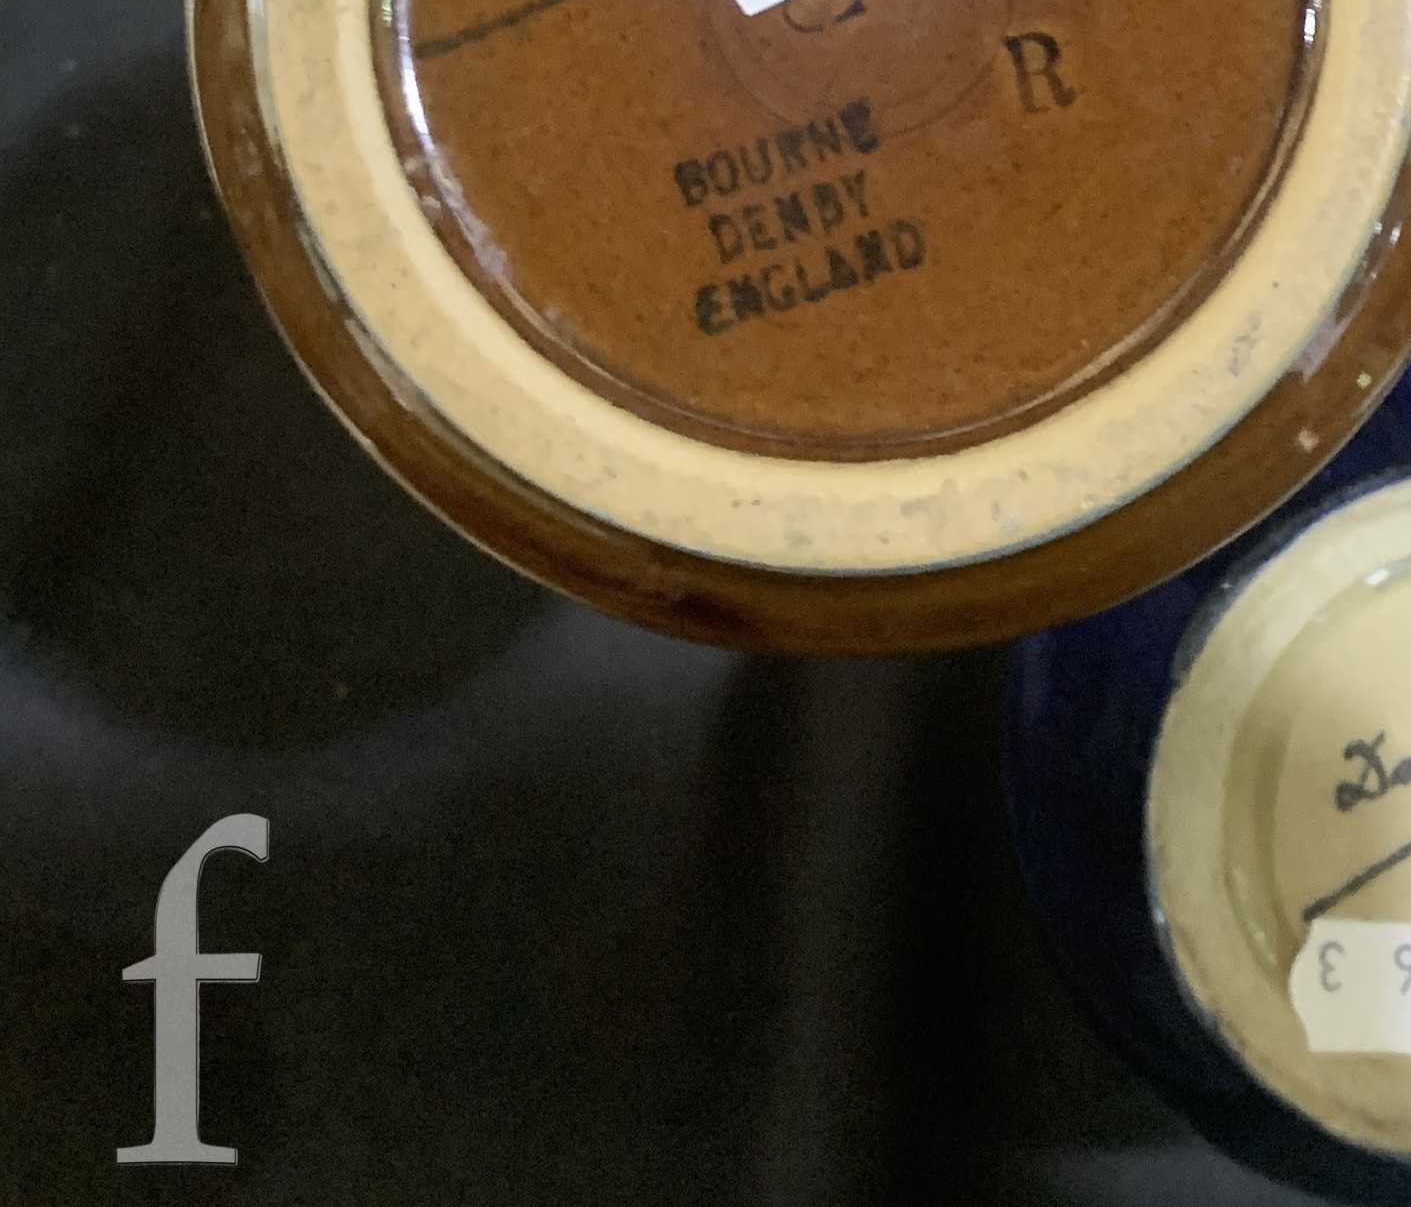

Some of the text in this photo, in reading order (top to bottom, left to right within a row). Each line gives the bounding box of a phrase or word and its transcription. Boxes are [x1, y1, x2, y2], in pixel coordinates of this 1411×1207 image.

[1001, 30, 1077, 115] R
[672, 96, 882, 210] BOURNE
[707, 168, 870, 266] DENBY
[694, 218, 929, 338] ENGLAND
[1318, 940, 1346, 993] 3
